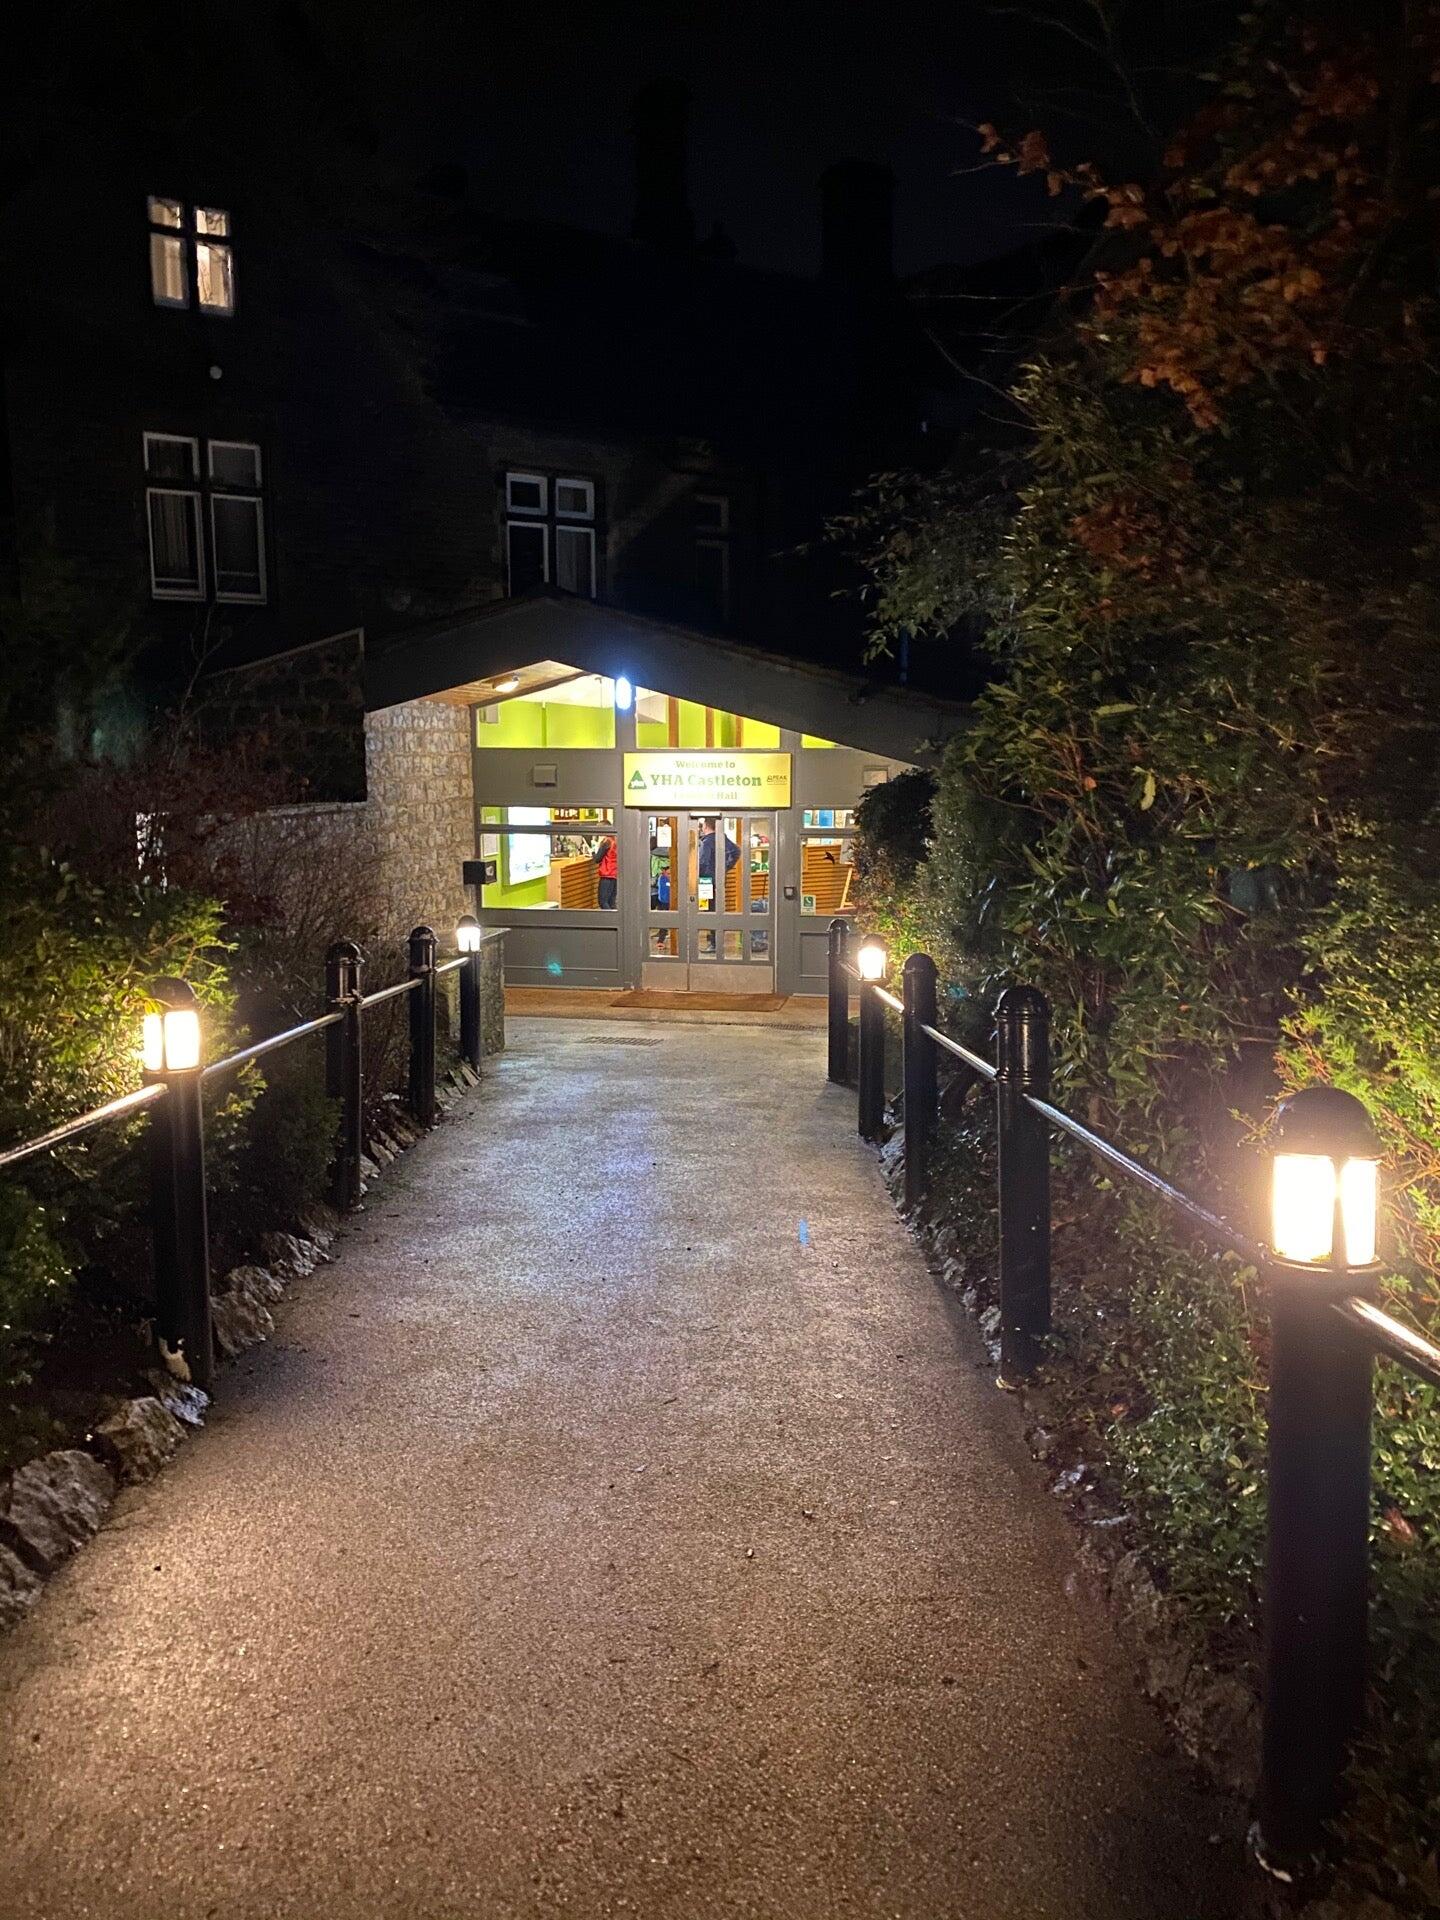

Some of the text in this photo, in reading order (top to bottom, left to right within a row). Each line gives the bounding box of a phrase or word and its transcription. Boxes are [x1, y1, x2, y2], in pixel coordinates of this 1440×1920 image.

[675, 760, 736, 769] Welcome to
[650, 774, 684, 786] YHA
[687, 774, 762, 787] Castleton
[716, 791, 738, 800] Hall
